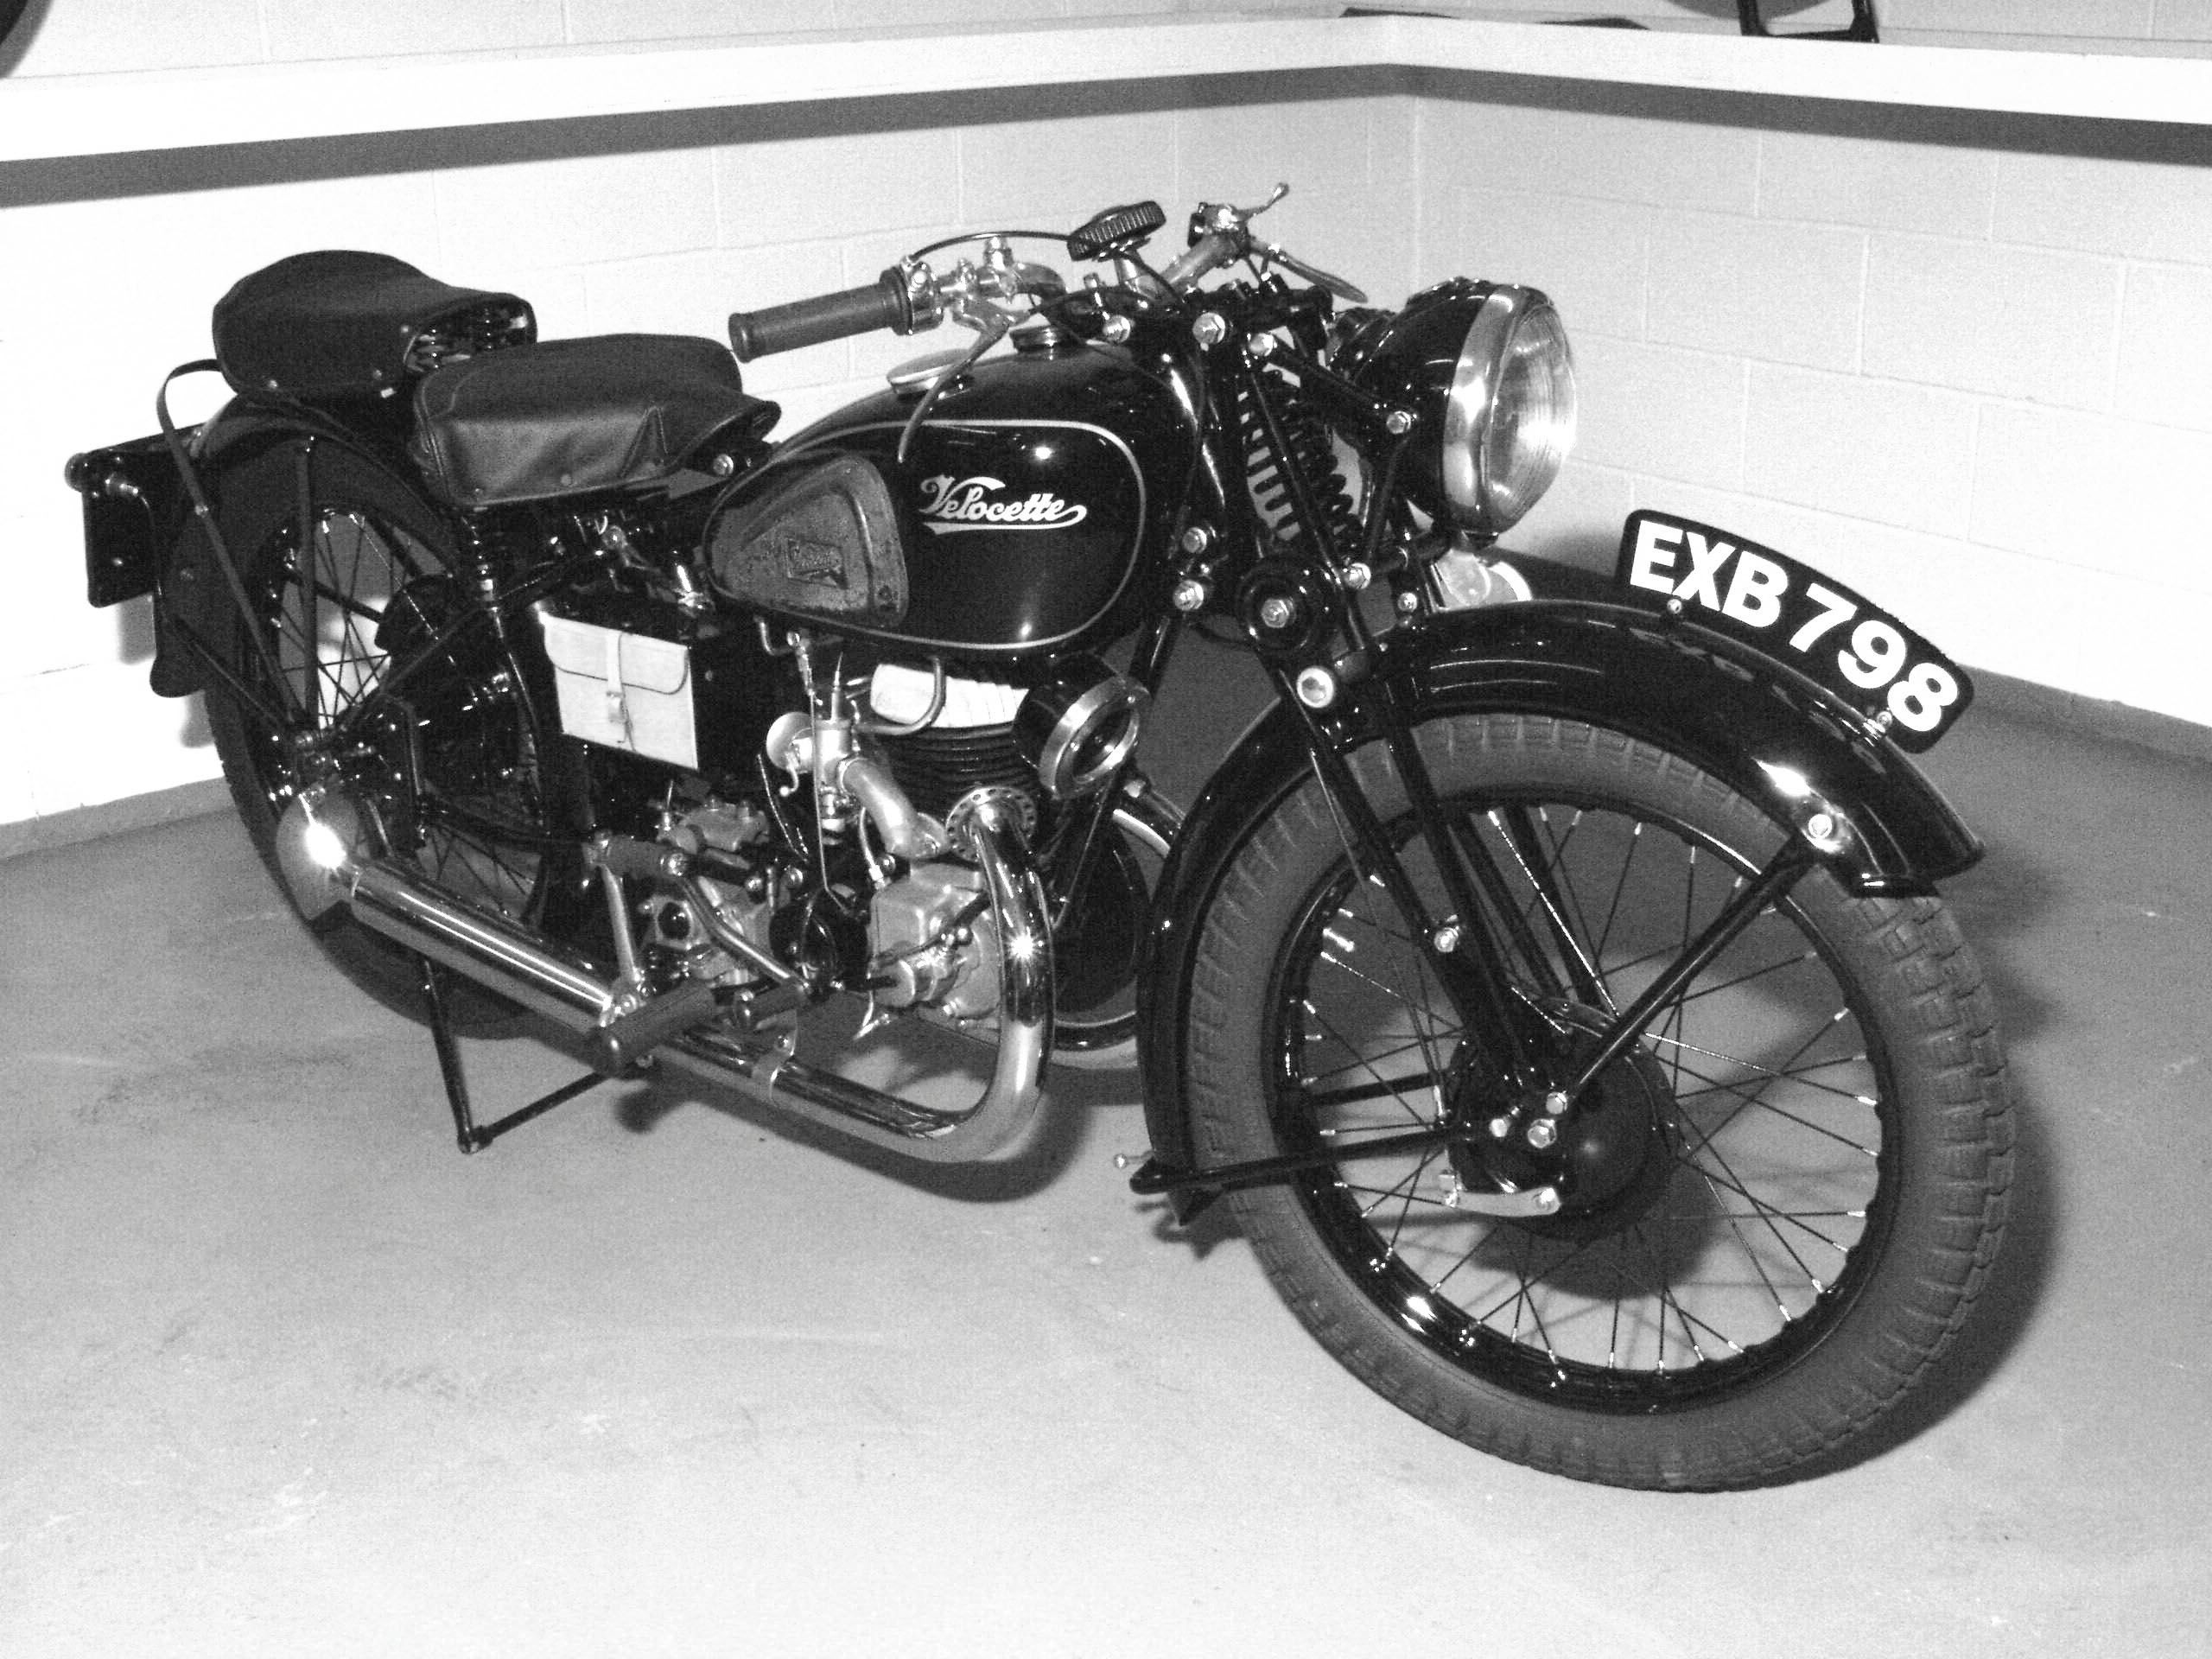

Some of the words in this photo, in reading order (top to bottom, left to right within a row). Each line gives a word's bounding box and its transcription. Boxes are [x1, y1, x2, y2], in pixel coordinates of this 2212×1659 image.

[919, 474, 1087, 535] Velocette
[1630, 520, 1788, 627] EXB
[1789, 583, 1958, 732] 798
